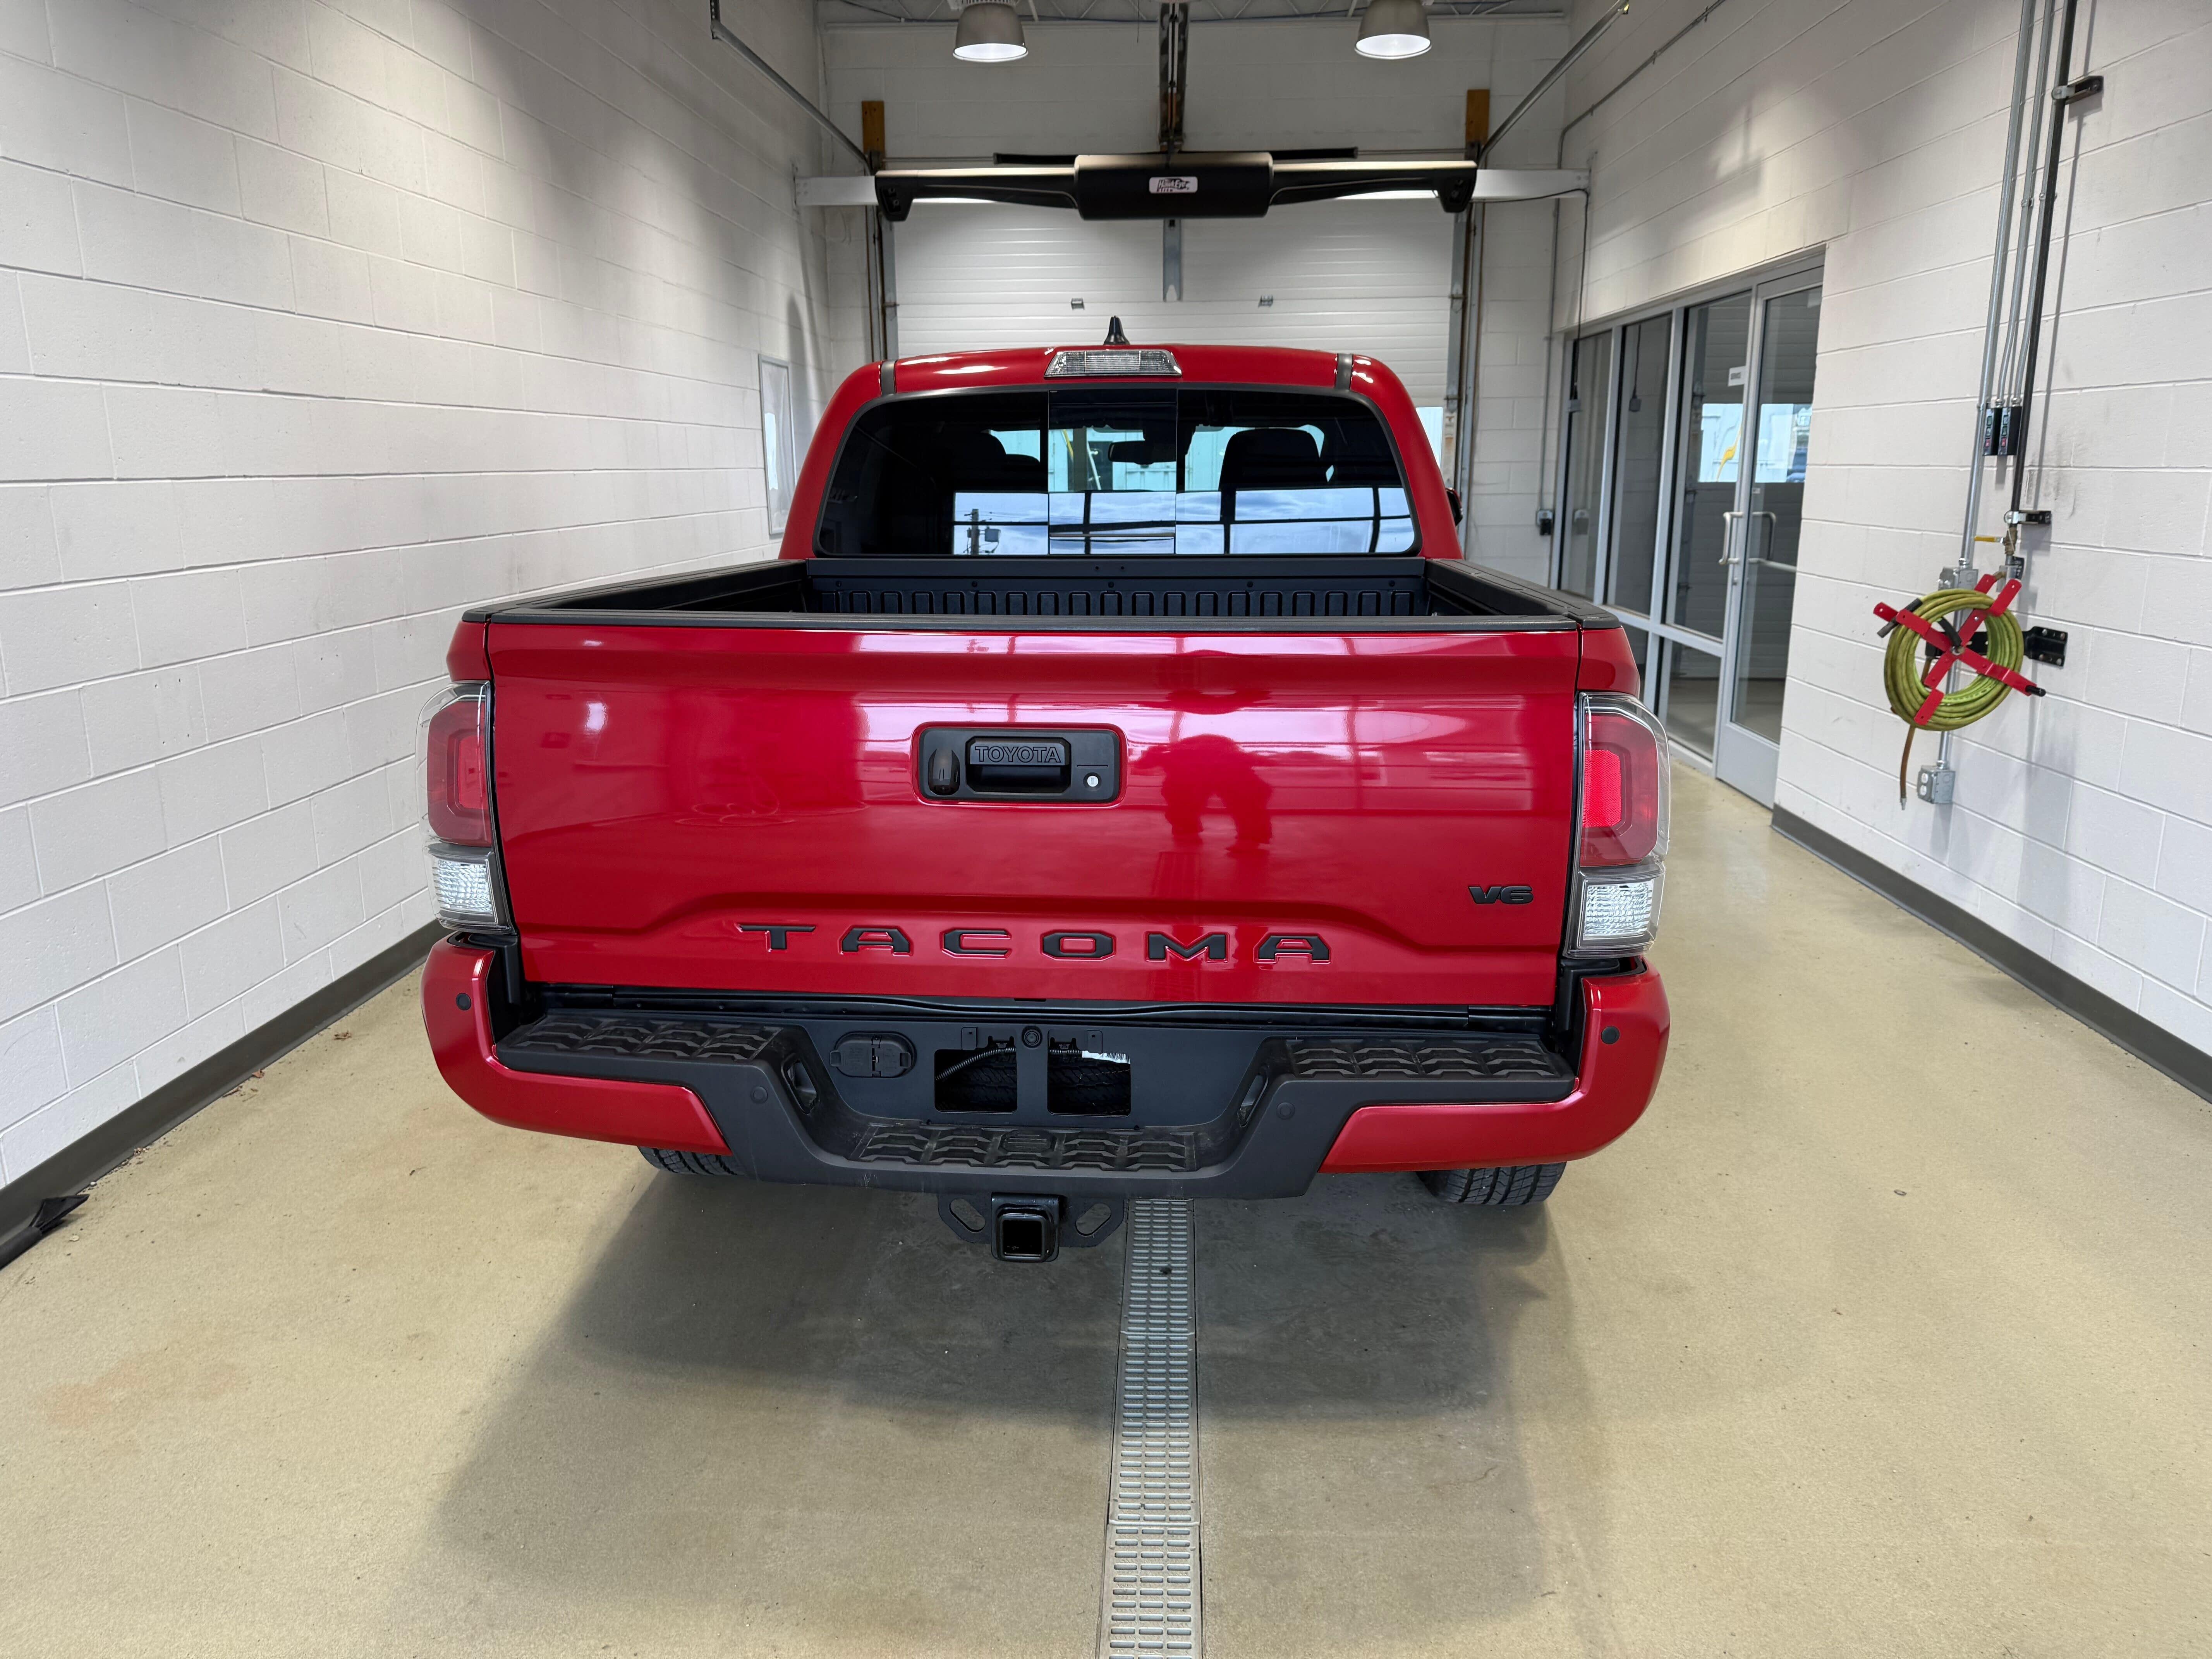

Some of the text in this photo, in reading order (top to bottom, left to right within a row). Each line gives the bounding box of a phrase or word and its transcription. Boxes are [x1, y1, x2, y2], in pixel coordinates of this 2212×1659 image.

[975, 746, 1061, 763] TOYOTA
[1468, 885, 1534, 904] V6
[738, 924, 1331, 963] TACOMA
